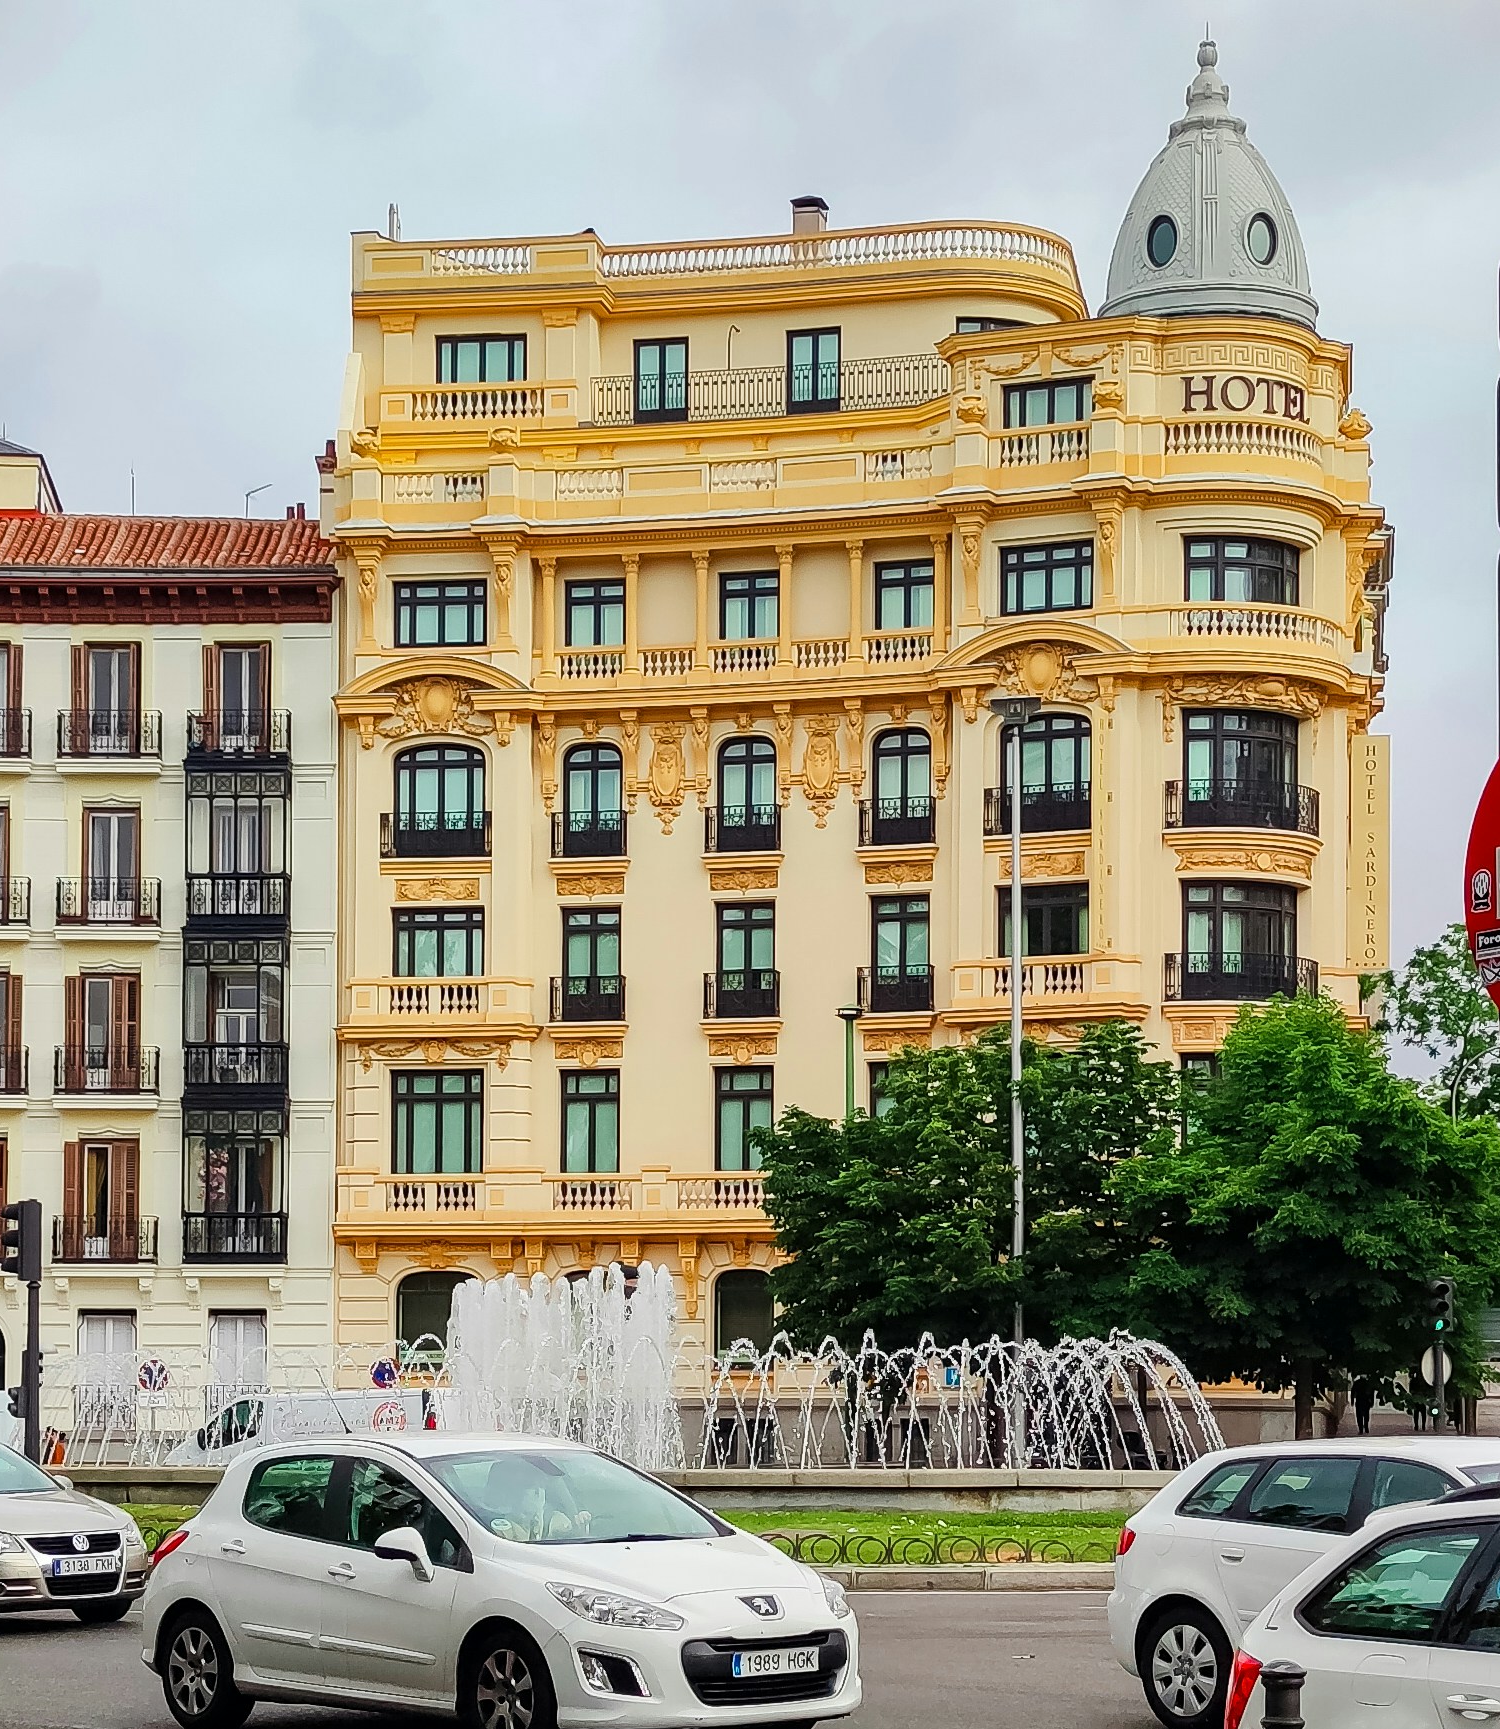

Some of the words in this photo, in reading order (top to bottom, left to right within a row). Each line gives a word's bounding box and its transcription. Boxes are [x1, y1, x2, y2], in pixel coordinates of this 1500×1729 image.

[1179, 374, 1311, 426] HOTEL
[1365, 744, 1377, 816] HOTEL
[1364, 832, 1377, 960] SARDINERO
[747, 1653, 781, 1673] 1989
[787, 1650, 816, 1670] HGK
